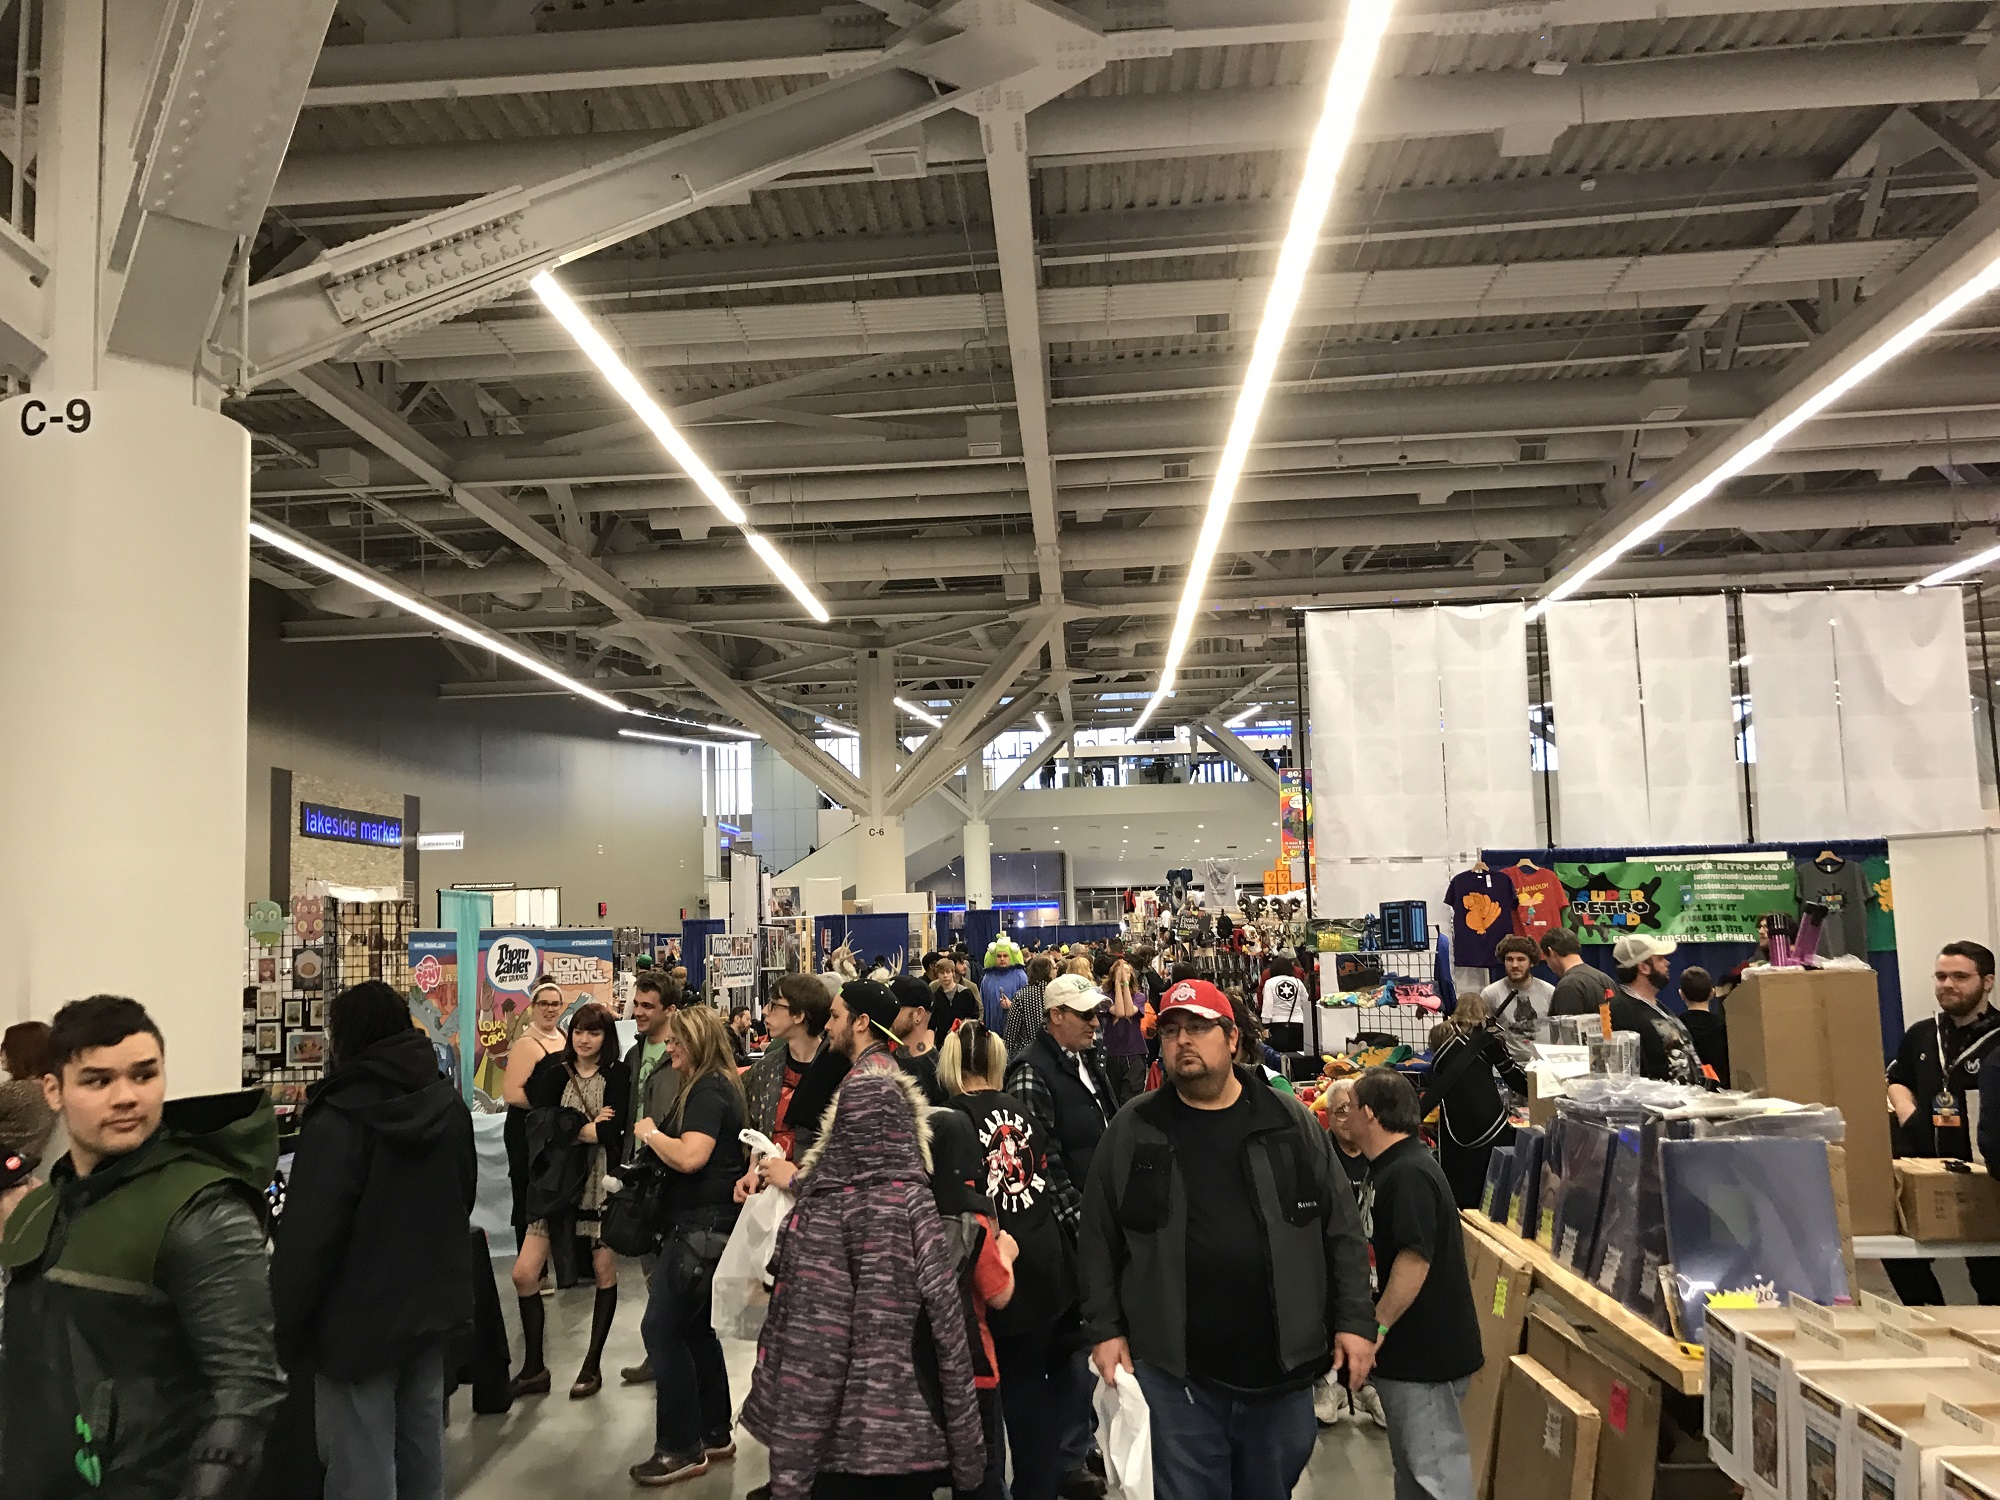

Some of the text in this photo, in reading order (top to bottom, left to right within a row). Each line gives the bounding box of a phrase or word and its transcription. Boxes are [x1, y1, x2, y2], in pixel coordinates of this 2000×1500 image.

[21, 398, 91, 436] C-9
[1283, 786, 1309, 794] MYSTEY
[306, 808, 400, 844] lakeside market
[868, 827, 885, 837] C-6
[1576, 889, 1646, 903] SUPER
[1573, 900, 1650, 915] RETRO
[1583, 913, 1641, 927] LAND
[1715, 933, 1757, 942] APPAREL
[497, 943, 530, 961] Thom
[495, 958, 532, 977] Zahler
[552, 956, 599, 972] LONG
[498, 975, 508, 983] ART
